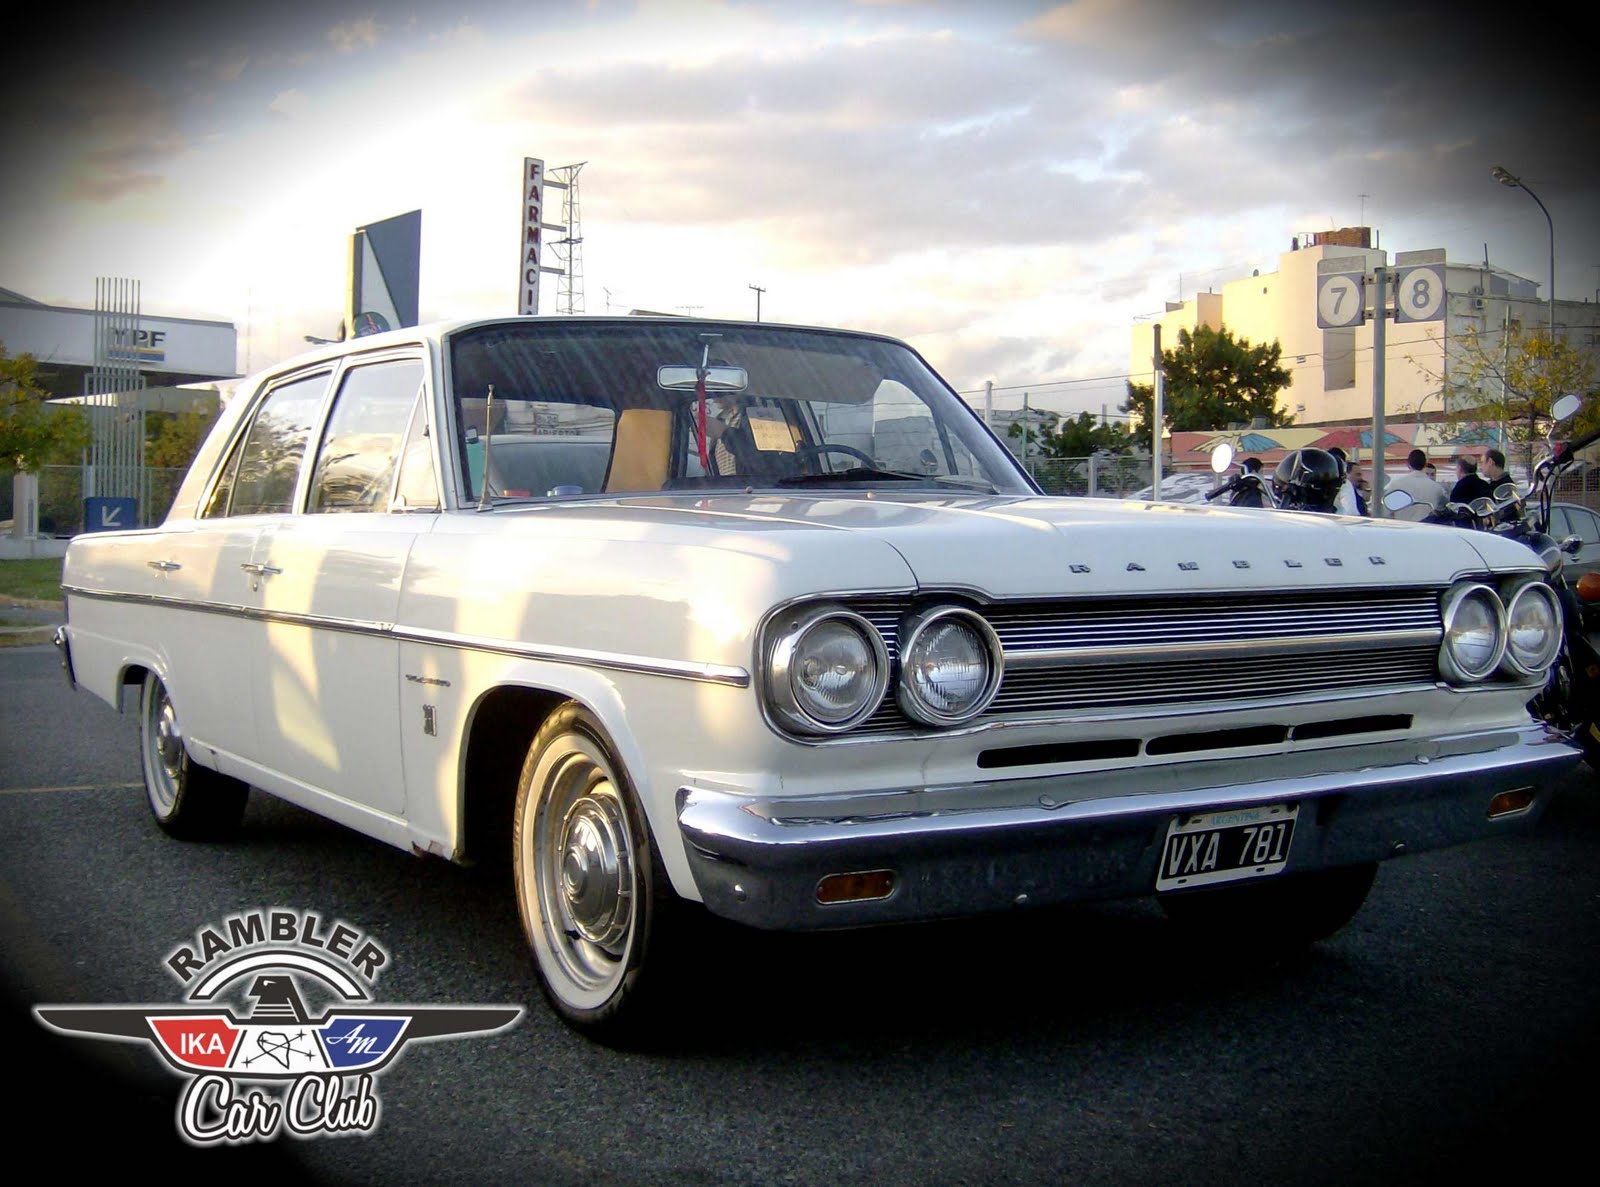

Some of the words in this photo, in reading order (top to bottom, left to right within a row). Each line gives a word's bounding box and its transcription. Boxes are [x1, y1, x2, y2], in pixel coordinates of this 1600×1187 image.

[1330, 286, 1348, 315] 7
[1412, 278, 1430, 309] 8
[110, 328, 166, 347] YPF
[1068, 555, 1386, 574] RAMBLER
[1168, 832, 1221, 876] VXA
[1238, 823, 1287, 866] 781
